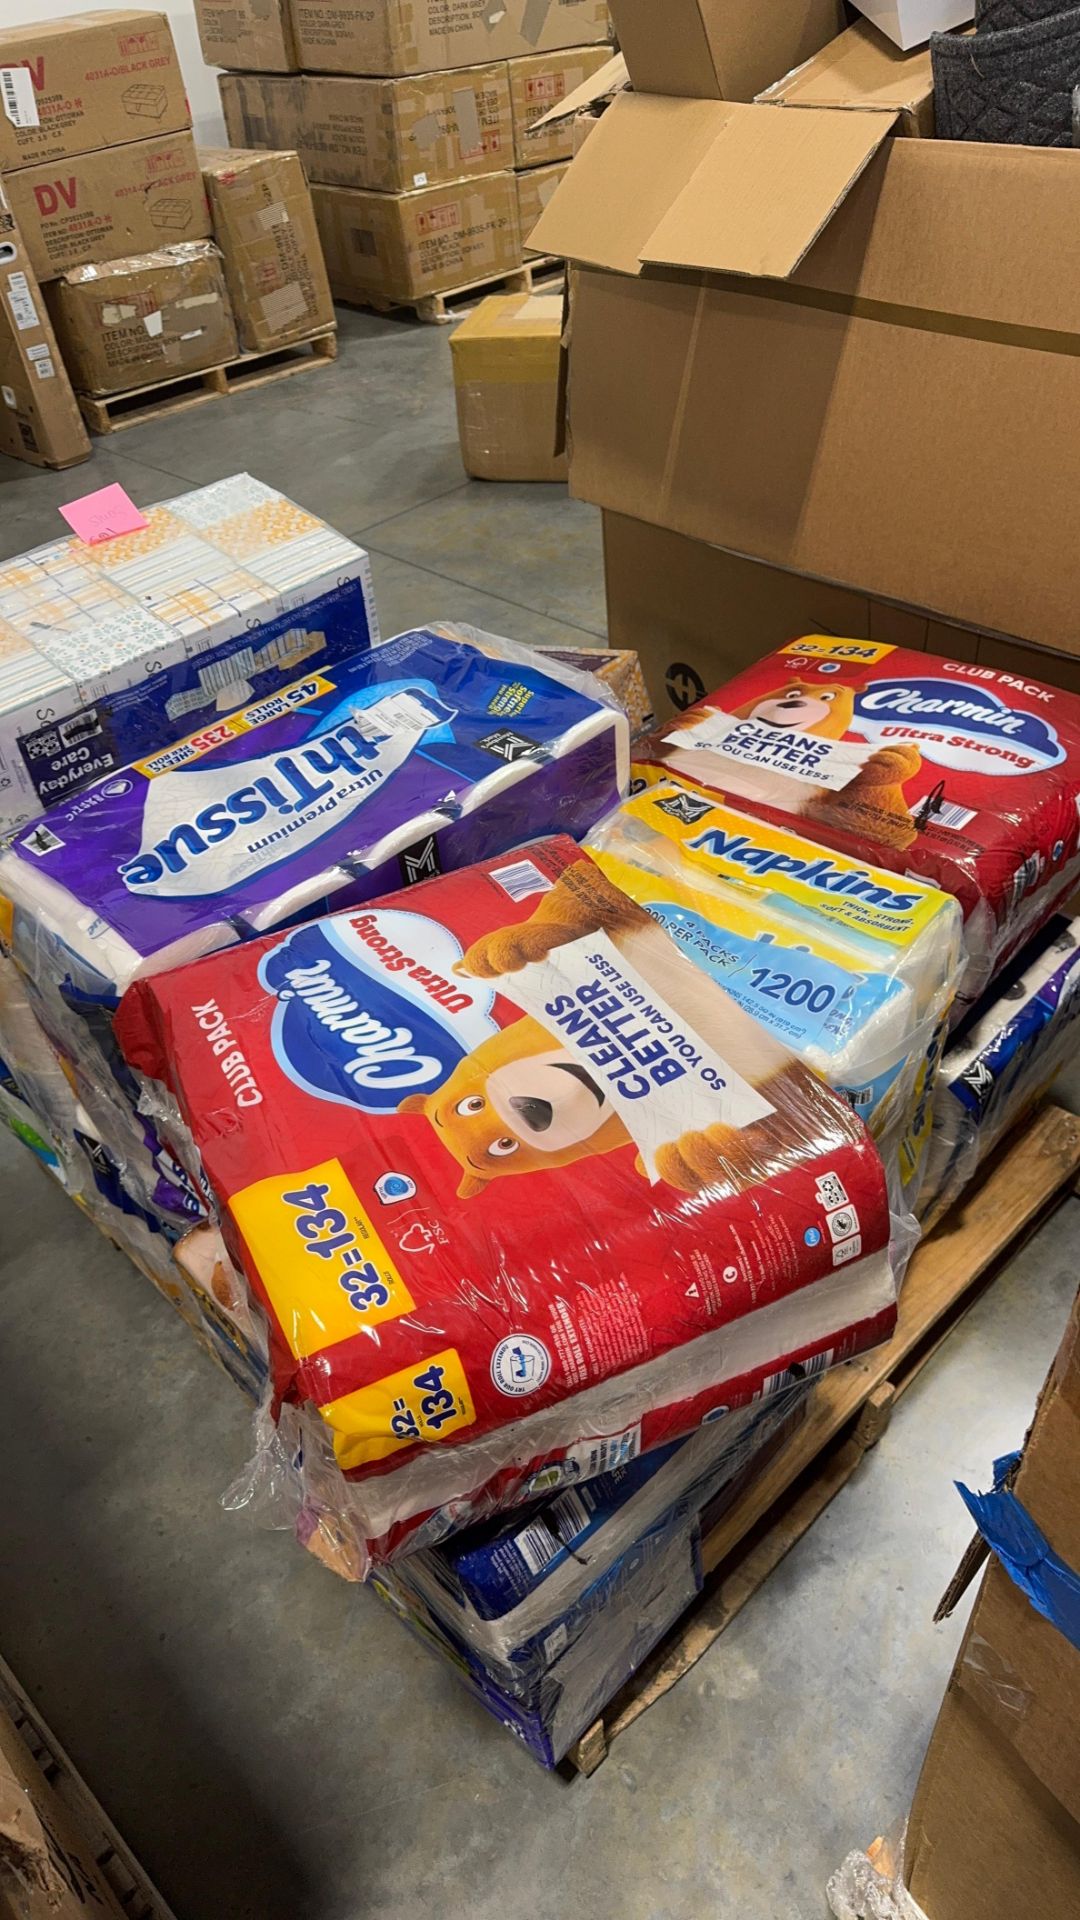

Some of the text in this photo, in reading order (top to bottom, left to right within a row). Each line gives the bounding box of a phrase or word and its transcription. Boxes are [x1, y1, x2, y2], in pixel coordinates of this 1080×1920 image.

[33, 177, 77, 217] DV
[100, 328, 128, 343] ITEM
[285, 679, 320, 706] 45
[942, 662, 1056, 703] CLUB PACK
[248, 699, 291, 727] LARGE
[860, 687, 1028, 735] Charmin
[145, 743, 189, 770] PER ROLL
[188, 721, 235, 755] 235
[735, 723, 834, 756] CLEANS
[880, 726, 1036, 770] Ultra Strong
[35, 751, 115, 796] Everyday
[48, 745, 91, 773] Care
[151, 747, 194, 773] SHEETS
[742, 750, 769, 765] CAN
[772, 758, 796, 772] USE
[117, 755, 335, 886] Tissue
[247, 768, 384, 854] Ultra Premium
[689, 829, 925, 911] Napkins
[818, 901, 911, 936] SOFT & ABSORBENT
[350, 914, 474, 1015] Ultra Strong
[663, 919, 694, 943] PER
[690, 938, 733, 970] PACK
[690, 928, 742, 964] PACKS
[616, 983, 646, 1013] USE
[750, 968, 836, 1013] 1200
[278, 959, 442, 1090] Charmin
[576, 978, 687, 1087] BETTER
[643, 1005, 674, 1034] CAN
[192, 999, 263, 1108] CLUB PACK
[545, 994, 651, 1100] CLEANS
[672, 1035, 703, 1069] YOU
[700, 1067, 727, 1091] SO
[427, 1219, 449, 1246] FSC
[555, 1299, 590, 1380] FREE ROLL EXTENDER
[413, 1365, 458, 1430] 134
